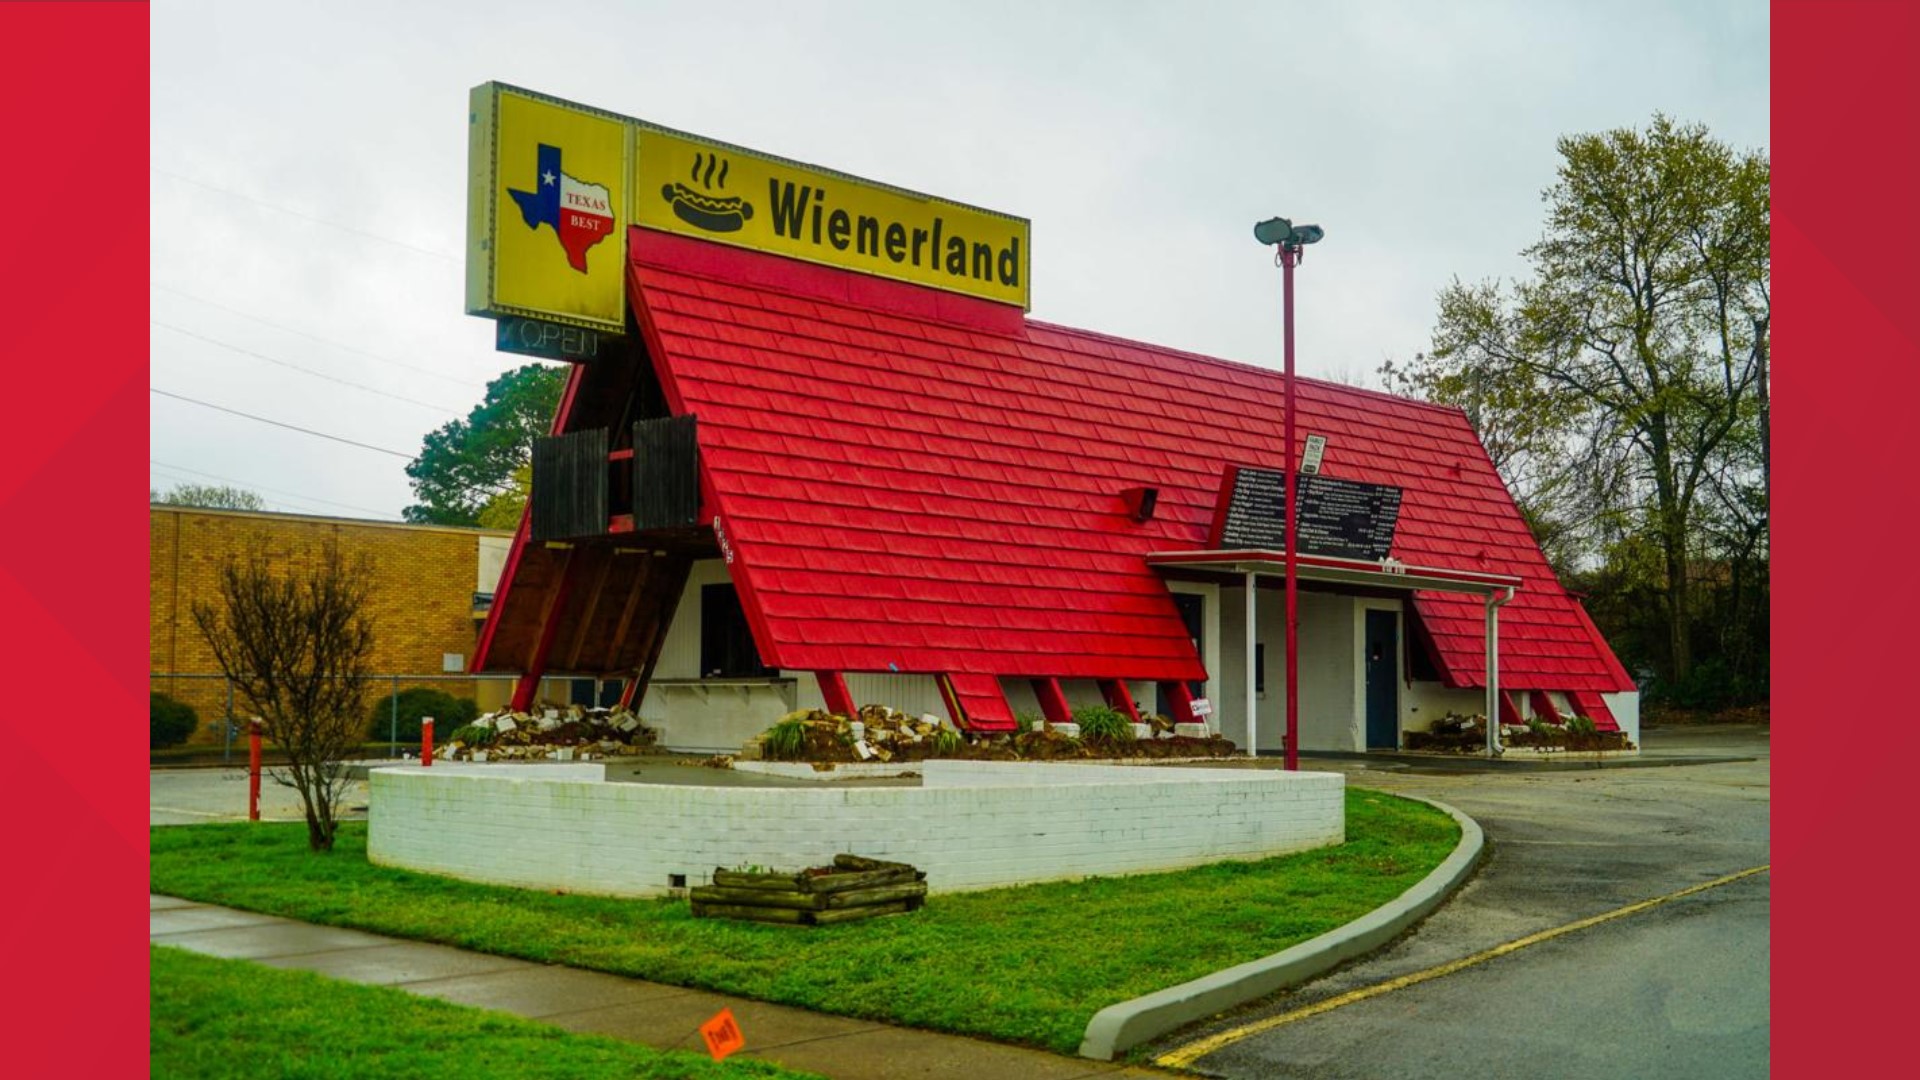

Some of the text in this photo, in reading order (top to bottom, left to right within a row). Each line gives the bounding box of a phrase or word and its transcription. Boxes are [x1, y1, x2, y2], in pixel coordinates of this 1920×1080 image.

[566, 192, 606, 211] TEXAS
[570, 215, 602, 231] BEST
[769, 178, 1019, 287] Wienerland
[520, 320, 598, 356] OPEN
